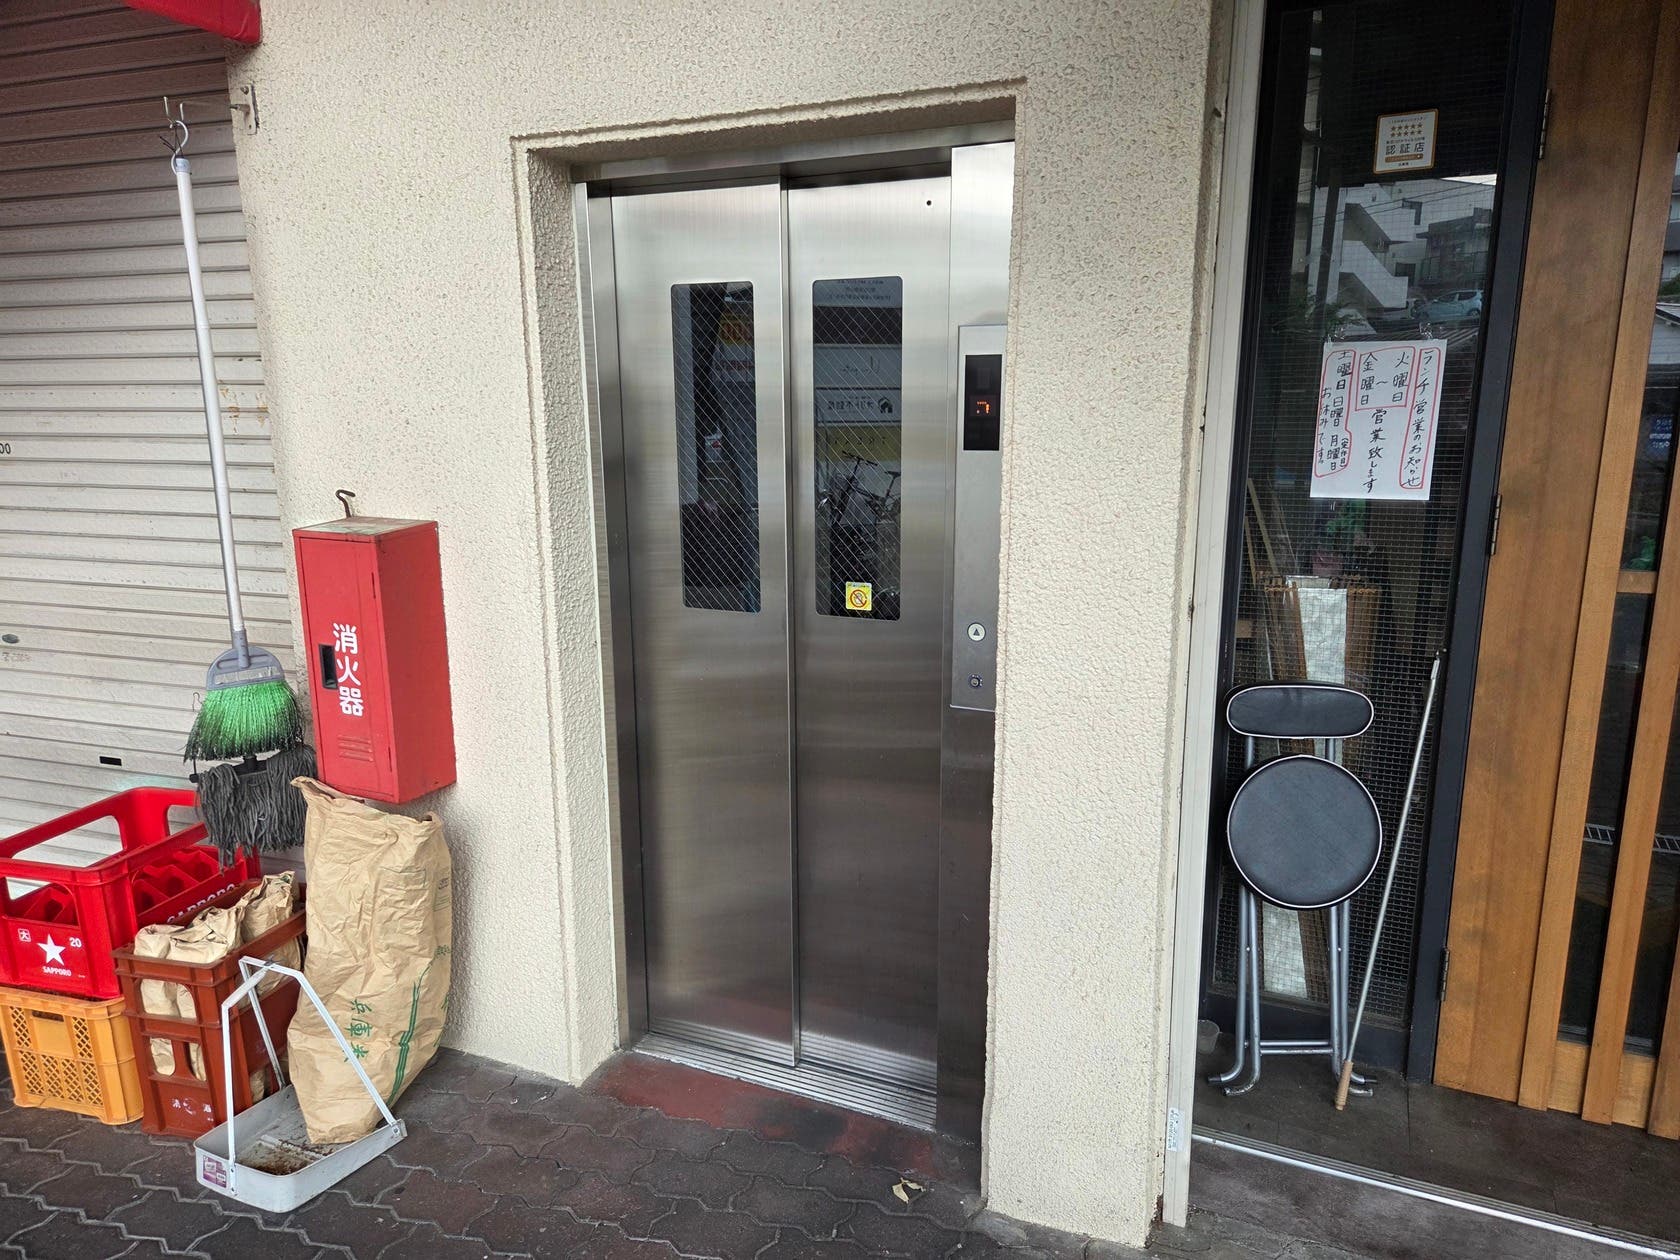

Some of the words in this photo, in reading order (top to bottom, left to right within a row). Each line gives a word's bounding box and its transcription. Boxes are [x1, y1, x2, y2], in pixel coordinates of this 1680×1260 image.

[1386, 142, 1425, 155] 認証店
[1360, 352, 1379, 406] 金曜日
[1402, 350, 1433, 487] ランチ営業のお知らせ
[1363, 408, 1388, 494] 営業致します
[332, 623, 364, 718] 消火器
[69, 937, 82, 948] 20
[42, 966, 72, 977] SAPPORO
